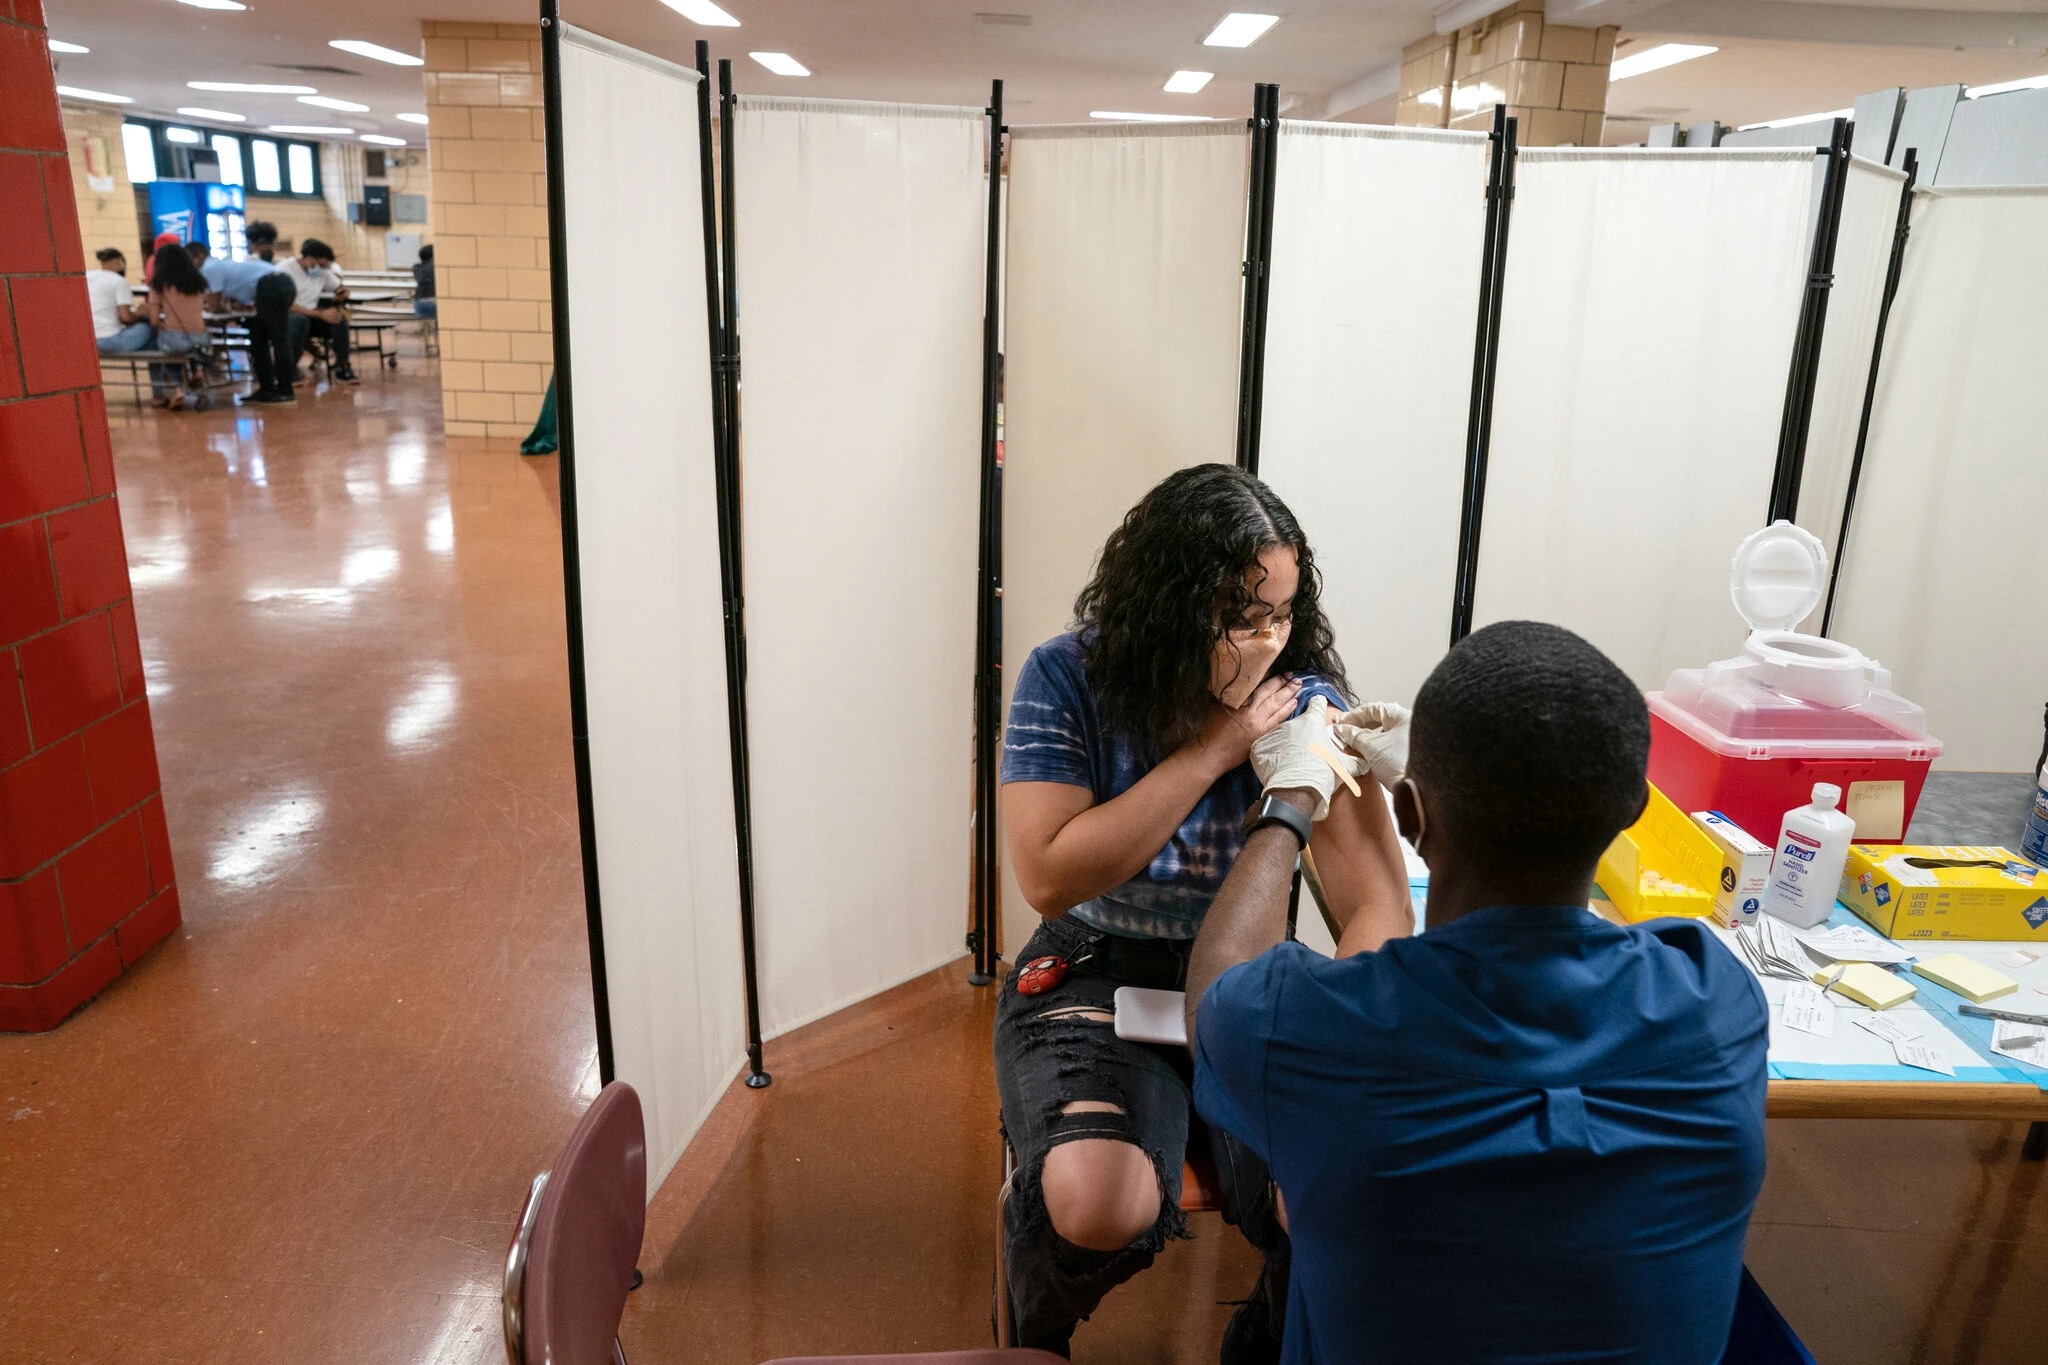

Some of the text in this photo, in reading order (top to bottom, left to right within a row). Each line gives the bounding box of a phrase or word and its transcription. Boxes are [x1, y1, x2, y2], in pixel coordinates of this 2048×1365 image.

[1787, 845, 1813, 861] Purell
[1783, 861, 1808, 875] SANITIZER
[1788, 859, 1804, 869] HAND
[1912, 893, 1928, 901] LATEX
[1908, 909, 1925, 917] LATEX
[2031, 907, 2048, 915] SAFET
[1912, 929, 1934, 937] L2323
